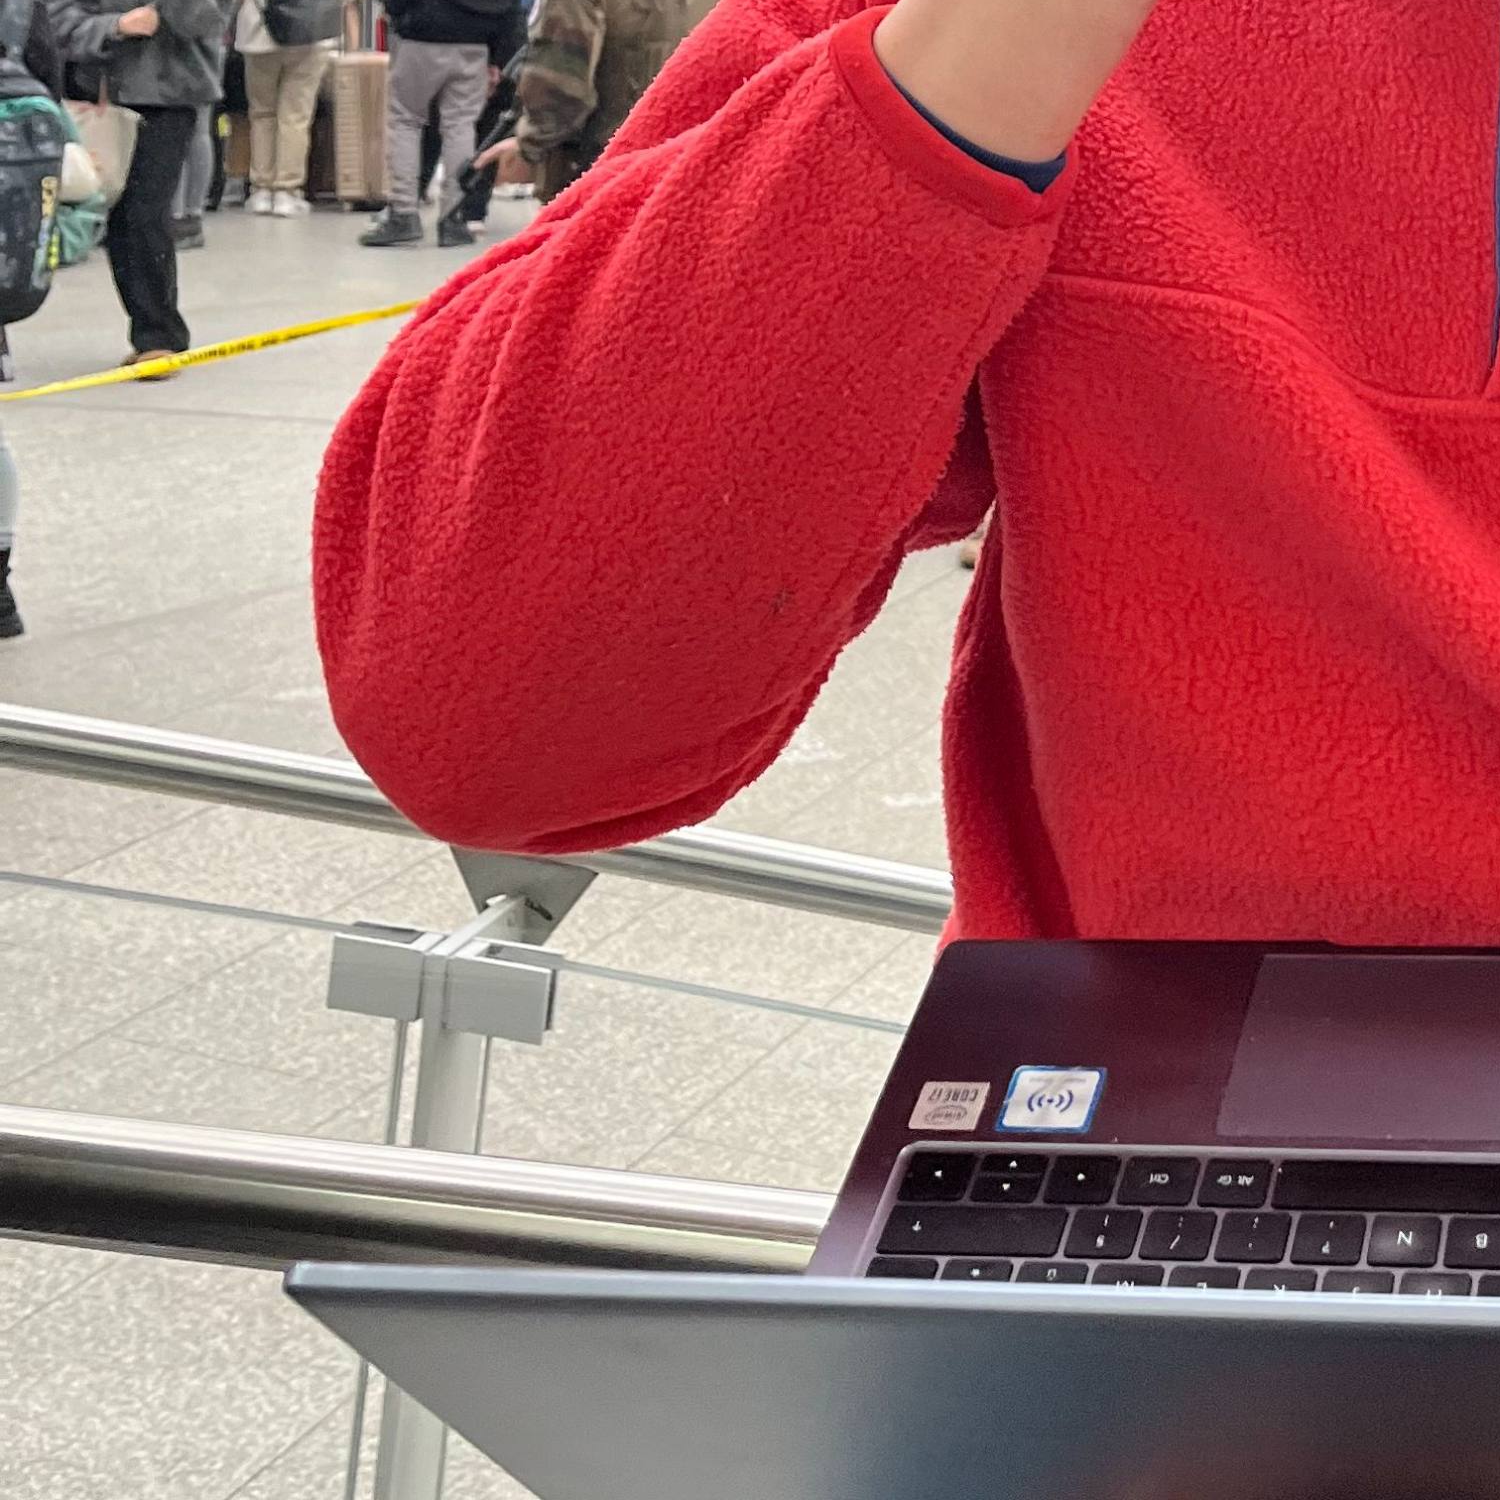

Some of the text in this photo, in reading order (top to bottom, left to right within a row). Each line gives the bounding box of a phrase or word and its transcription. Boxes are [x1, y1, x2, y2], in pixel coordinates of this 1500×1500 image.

[944, 1088, 979, 1102] CORE
[1149, 1173, 1169, 1184] Ctrl
[1216, 1173, 1254, 1185] Alt Gr
[1397, 1230, 1413, 1246] N
[1475, 1232, 1488, 1249] B
